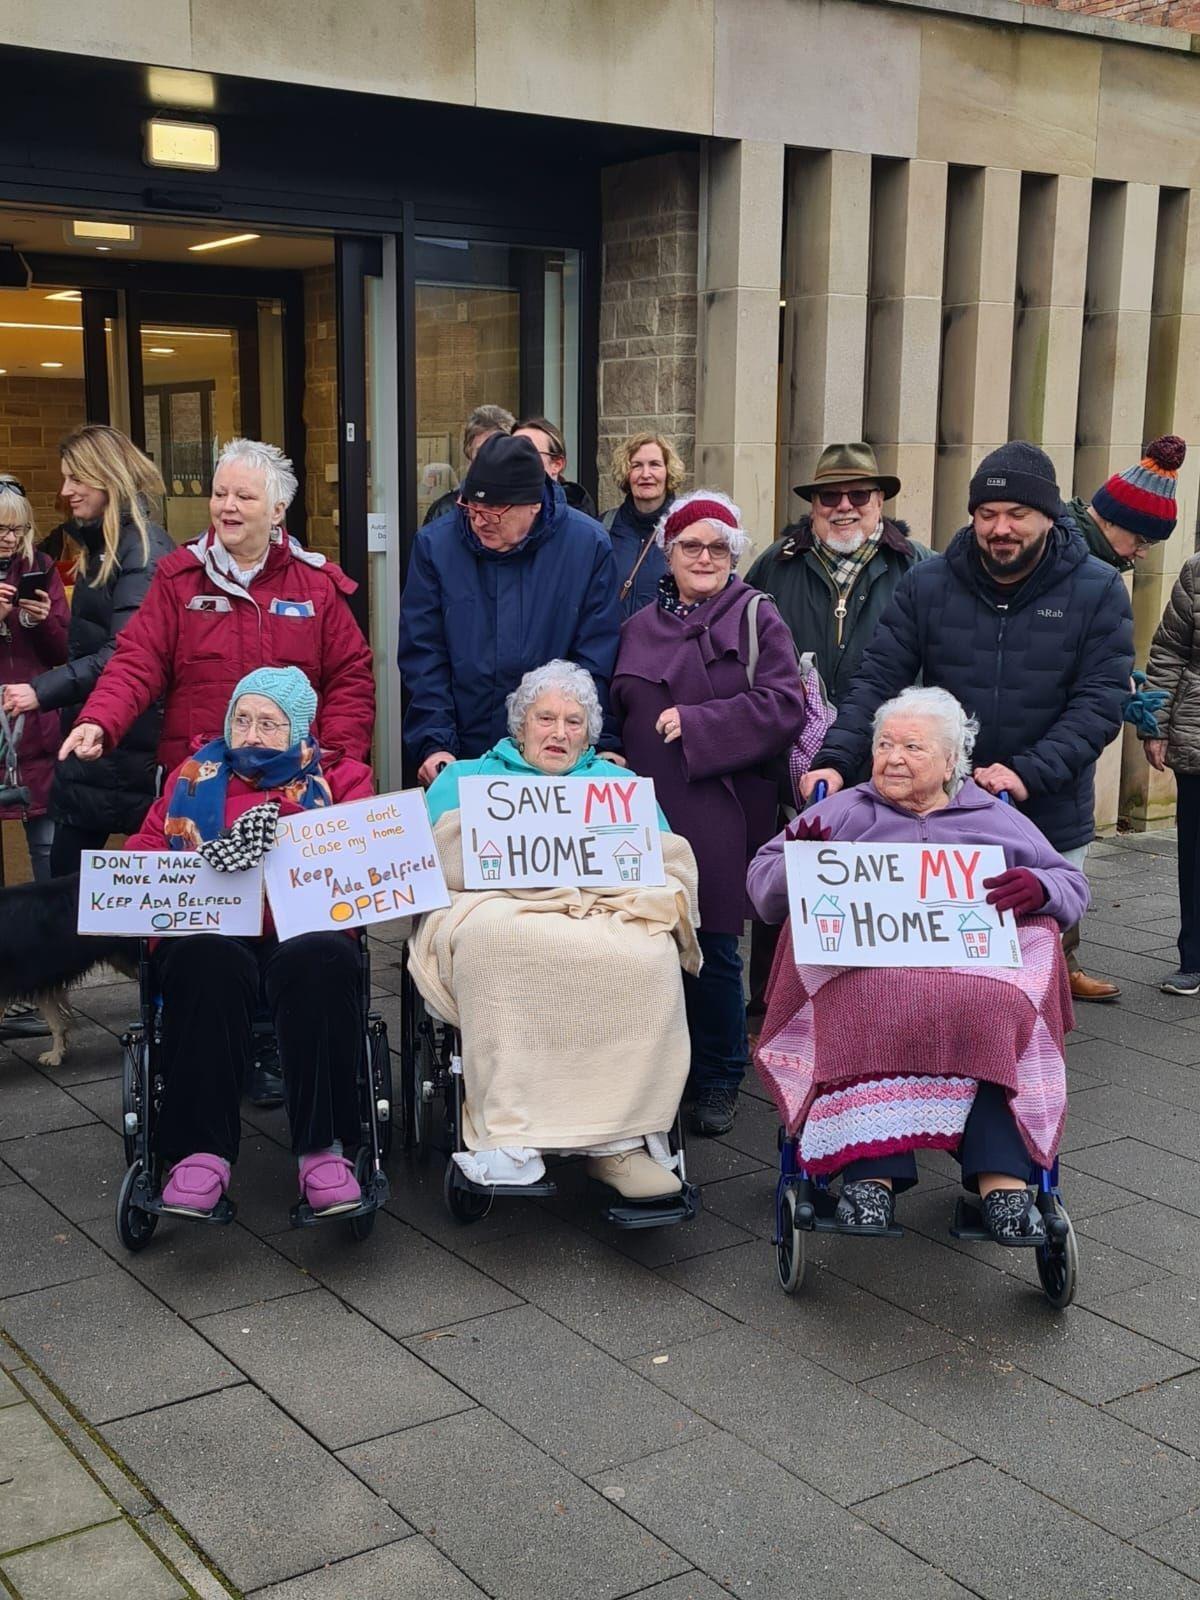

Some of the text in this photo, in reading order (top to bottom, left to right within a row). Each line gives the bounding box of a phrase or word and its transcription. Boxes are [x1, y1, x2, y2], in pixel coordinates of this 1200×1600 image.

[366, 804, 401, 823] don't
[487, 781, 638, 823] SAVE MY
[348, 836, 367, 855] my
[372, 825, 405, 839] home
[507, 835, 603, 876] HOME
[92, 854, 202, 870] DON'T MAKE
[289, 854, 436, 898] Keep Ada Belfield
[817, 849, 981, 899] SAVE MY
[113, 874, 196, 886] MOVE AWAY
[91, 892, 242, 911] KEEP ADA BELFIELD
[330, 884, 416, 922] OPEN
[151, 911, 221, 929] OPEN
[850, 902, 950, 947] HOME
